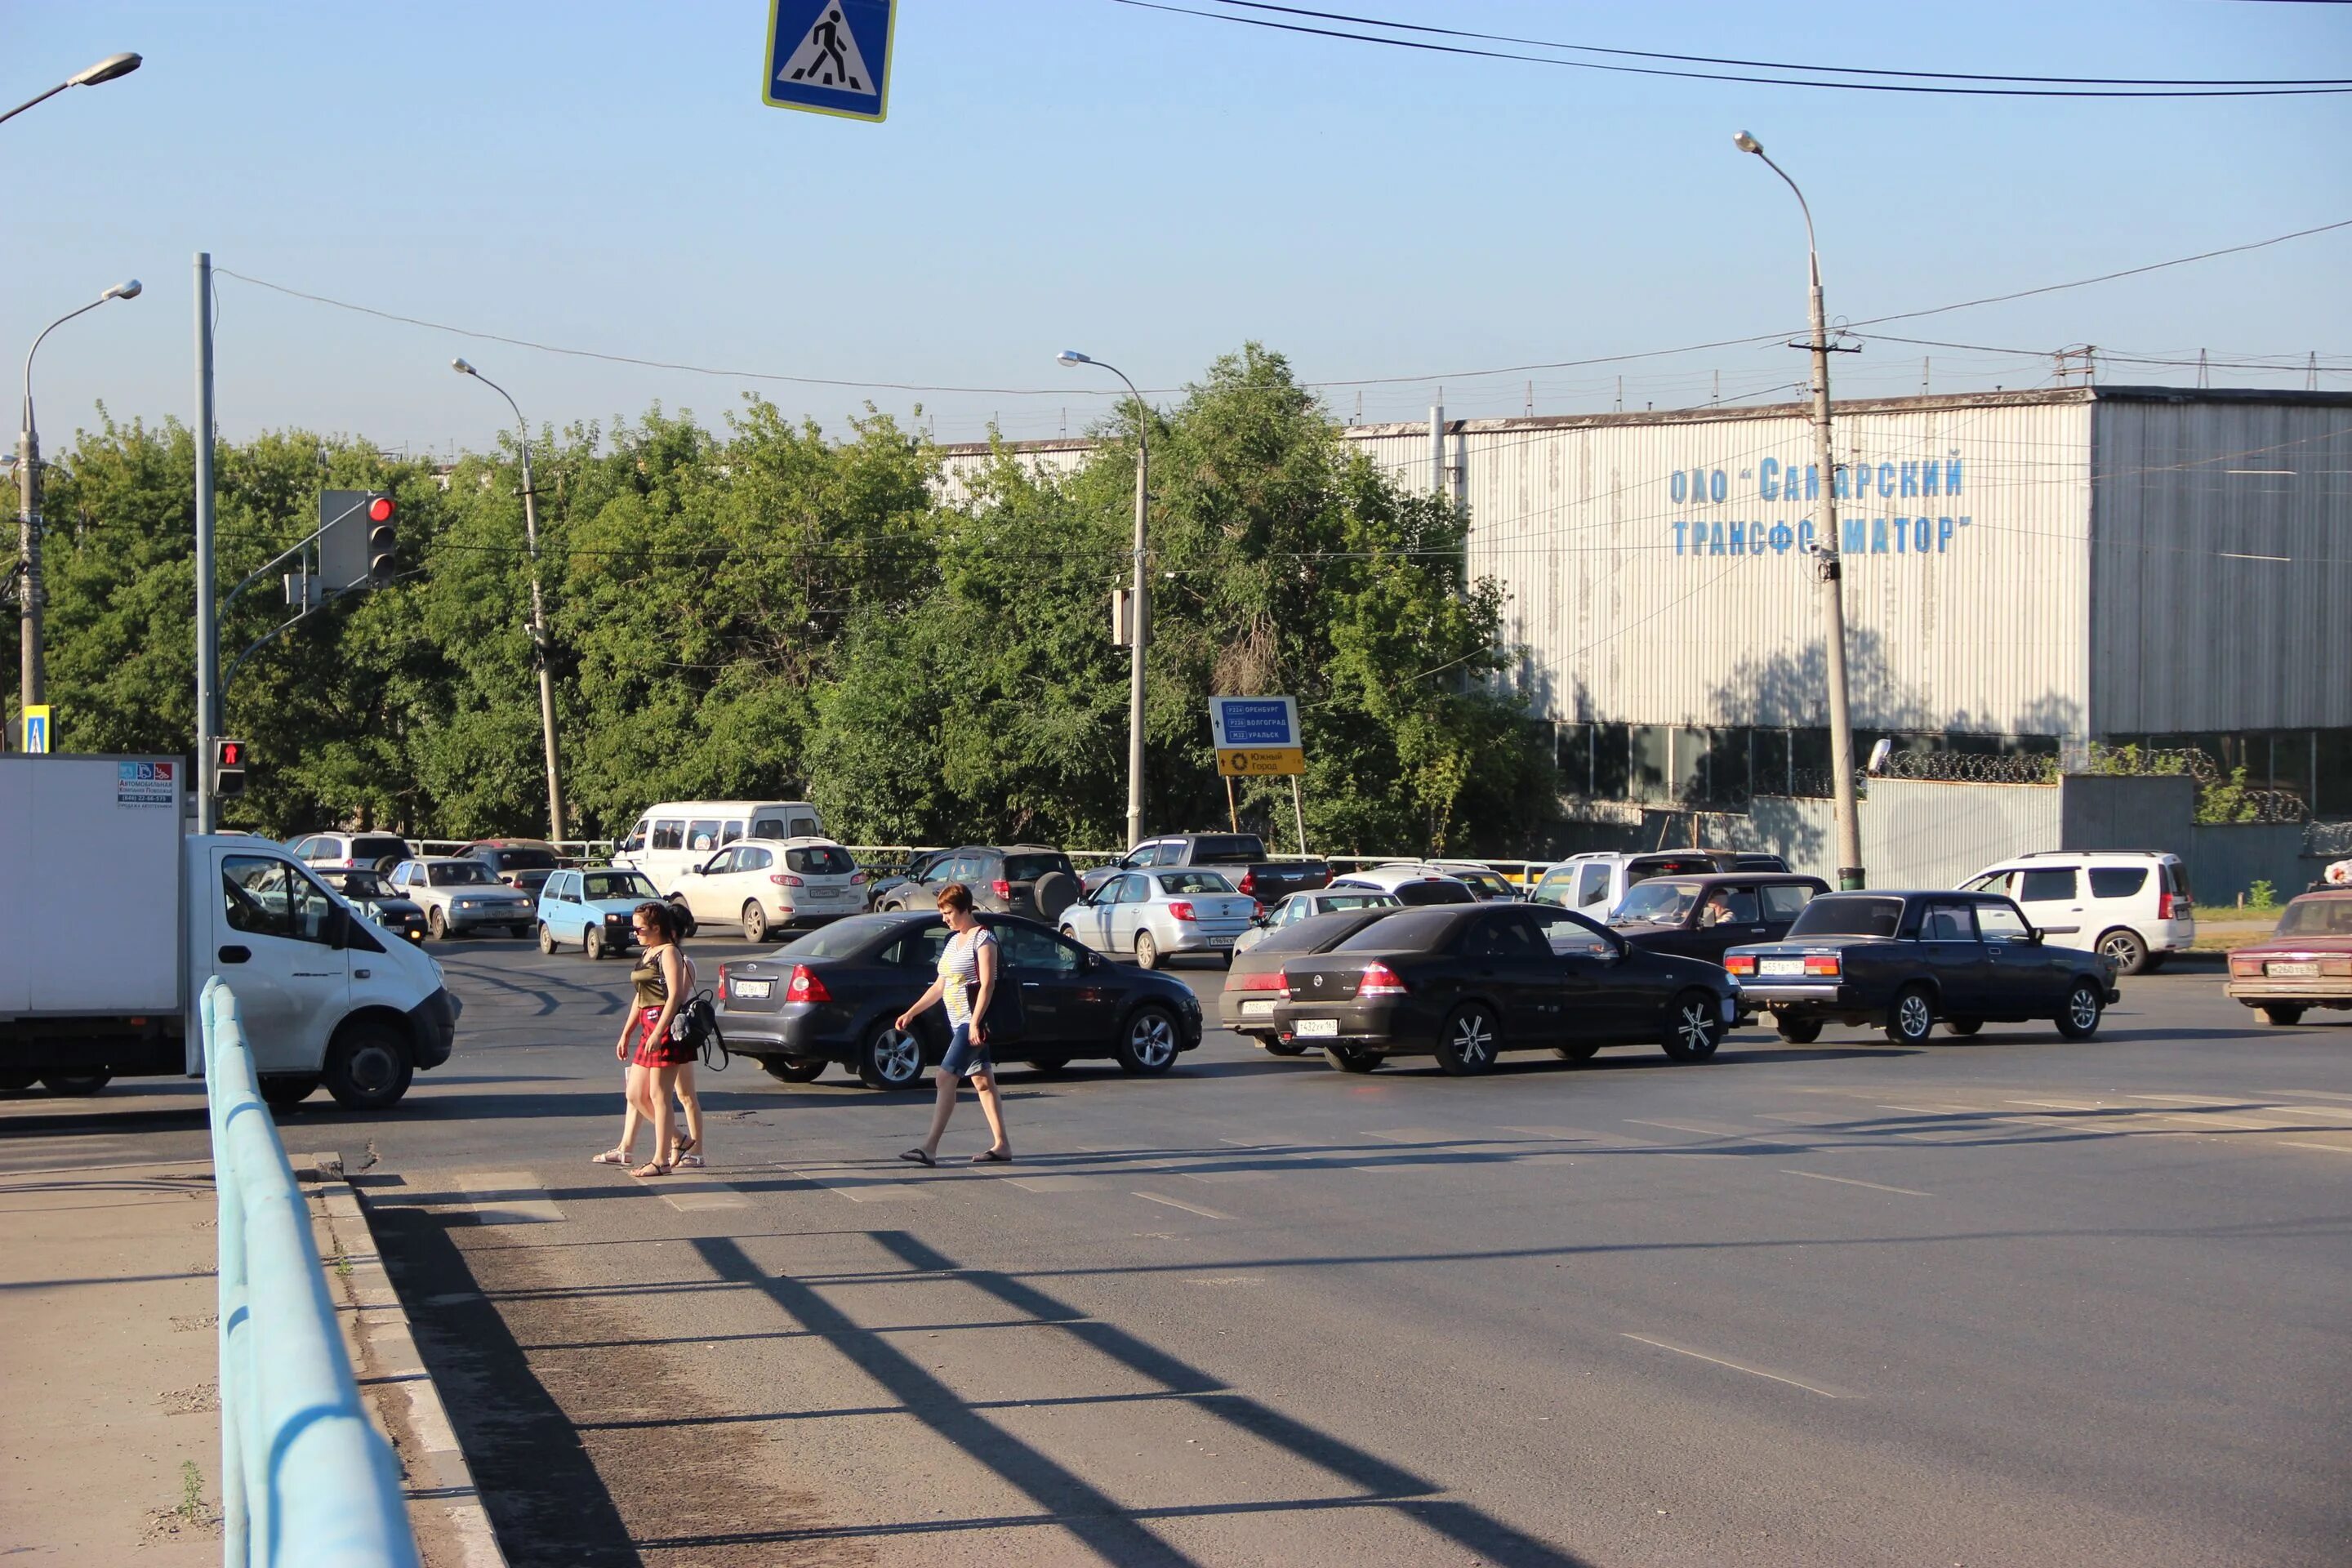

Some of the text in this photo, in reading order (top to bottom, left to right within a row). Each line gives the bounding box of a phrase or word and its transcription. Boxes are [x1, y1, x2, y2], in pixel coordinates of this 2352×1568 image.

[1670, 468, 1728, 505] ОАО
[1250, 752, 1283, 760] Южный
[1252, 763, 1278, 771] Город
